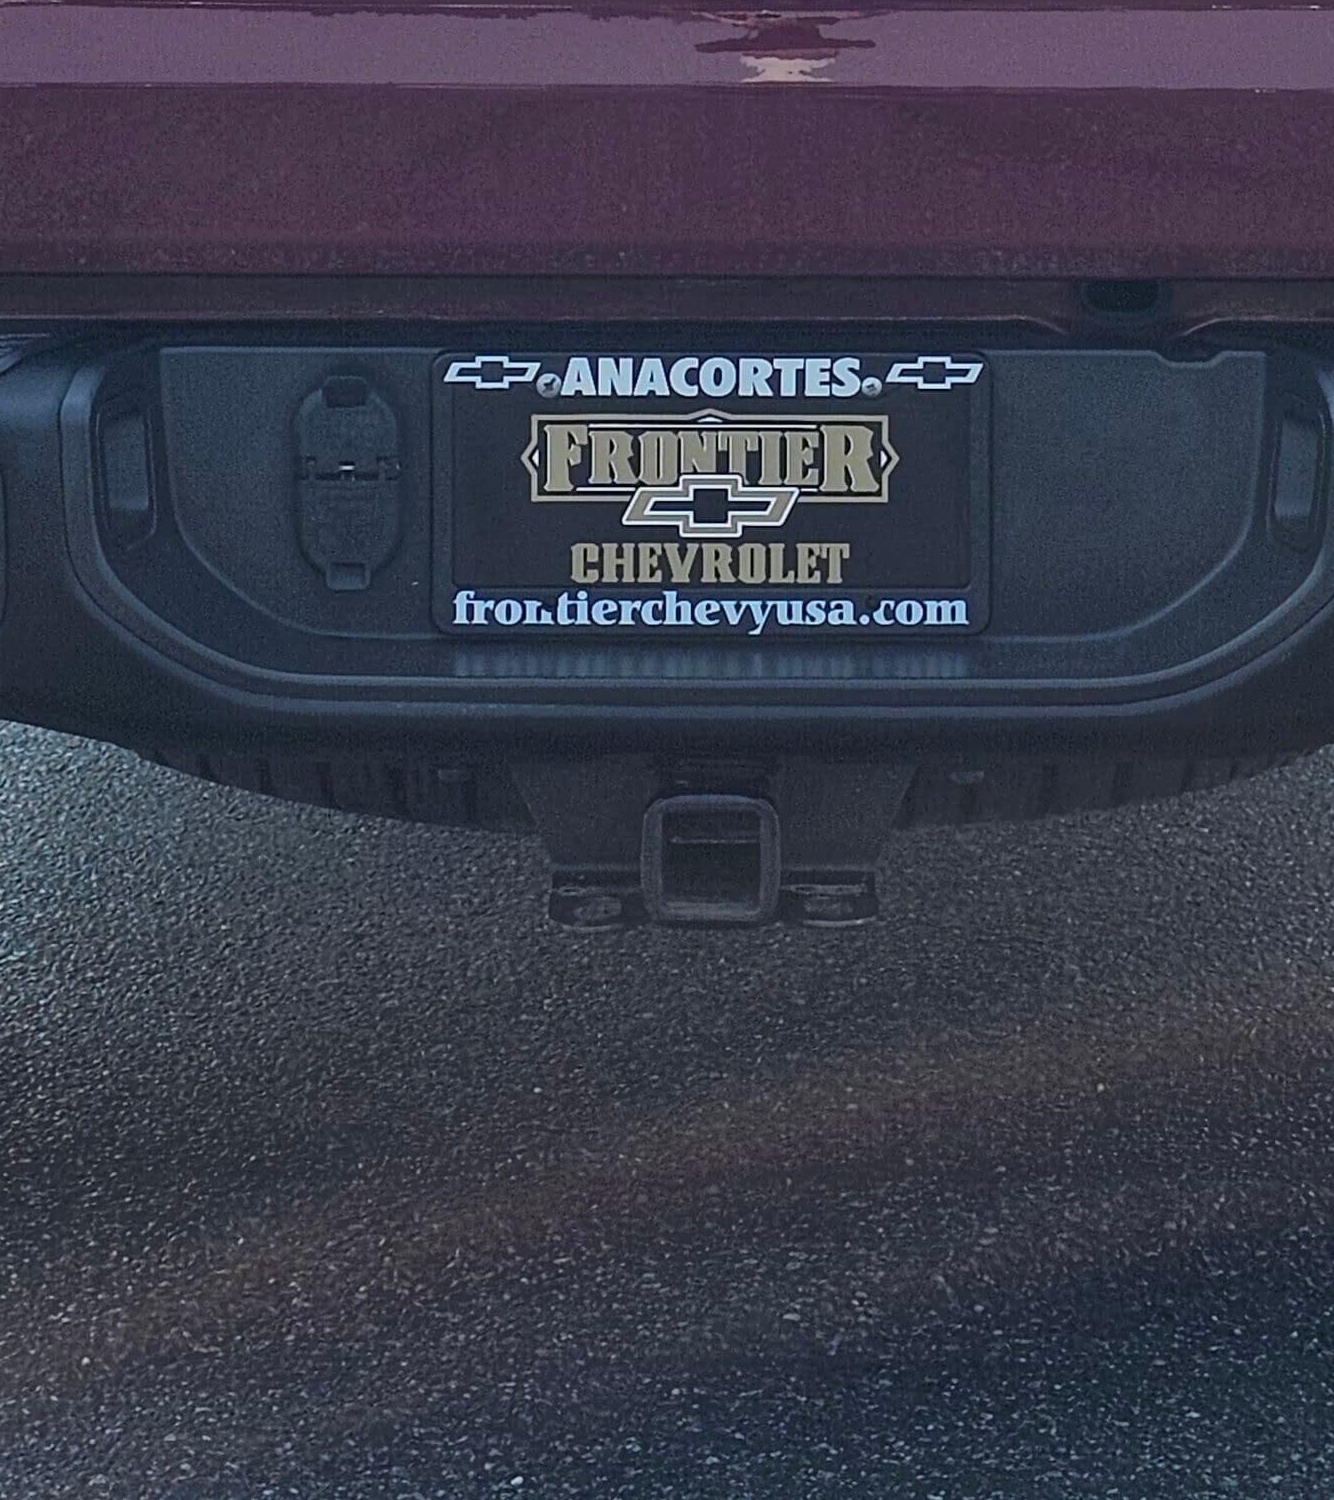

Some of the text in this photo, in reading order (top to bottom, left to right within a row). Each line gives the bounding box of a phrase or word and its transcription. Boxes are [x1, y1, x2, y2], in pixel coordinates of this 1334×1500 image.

[560, 357, 863, 398] ANACORTES
[543, 423, 880, 492] FRONTIER
[570, 542, 850, 584] CHEVROLET
[452, 590, 969, 635] frontierchevyusa.com
